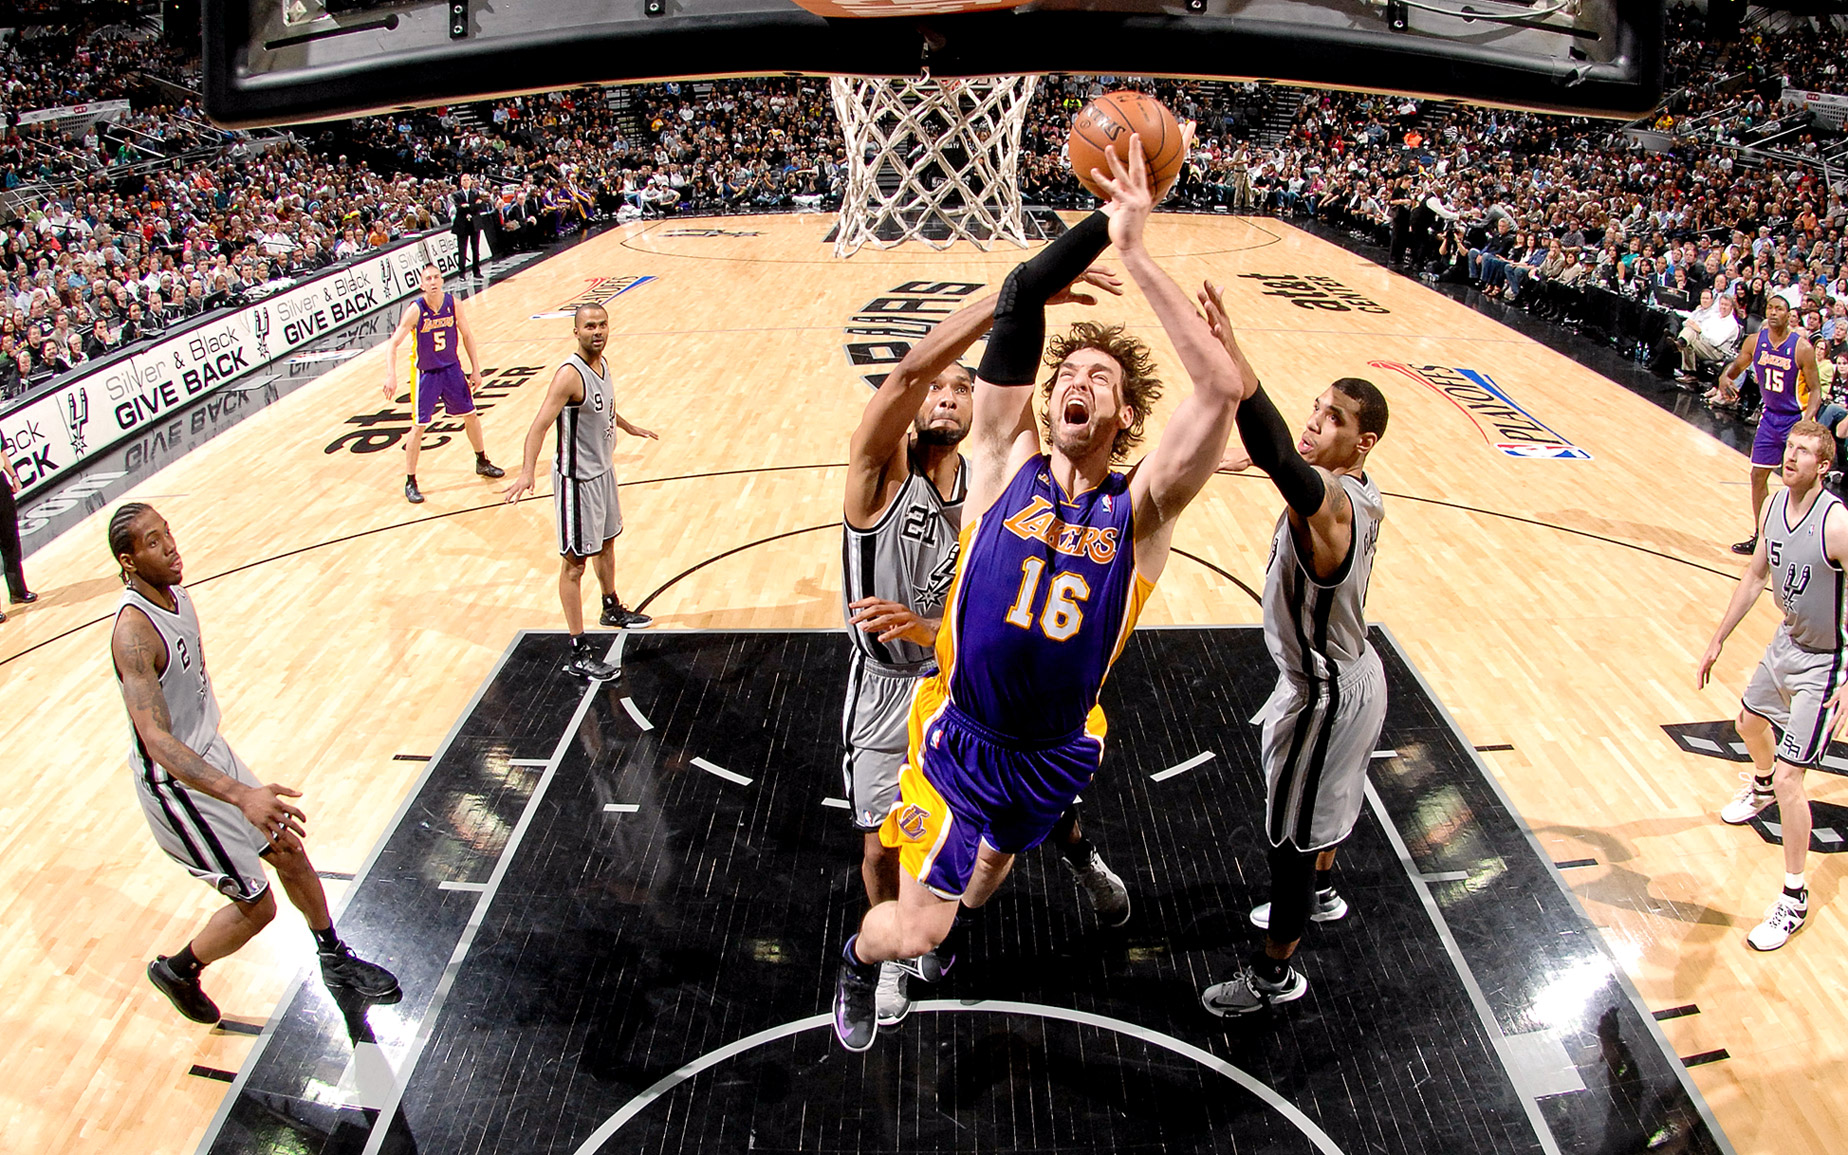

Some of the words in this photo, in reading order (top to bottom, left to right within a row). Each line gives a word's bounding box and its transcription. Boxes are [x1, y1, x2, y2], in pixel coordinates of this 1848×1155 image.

[277, 293, 319, 322] Silver
[323, 287, 333, 302] &
[334, 271, 372, 298] Black
[283, 309, 329, 345] GIVE
[330, 288, 378, 324] BACK
[105, 360, 167, 401] Silver
[172, 351, 186, 370] &
[188, 326, 240, 362] Black
[432, 330, 447, 352] 5
[114, 379, 180, 430] GIVE
[182, 346, 250, 395] BACK
[593, 391, 604, 415] 9
[1407, 363, 1563, 446] PLAYOFFS
[1763, 367, 1785, 394] 15
[5, 420, 46, 458] ack
[900, 503, 939, 548] 21
[1003, 495, 1120, 565] LAKERS
[1005, 555, 1091, 642] 16
[175, 635, 191, 674] 2
